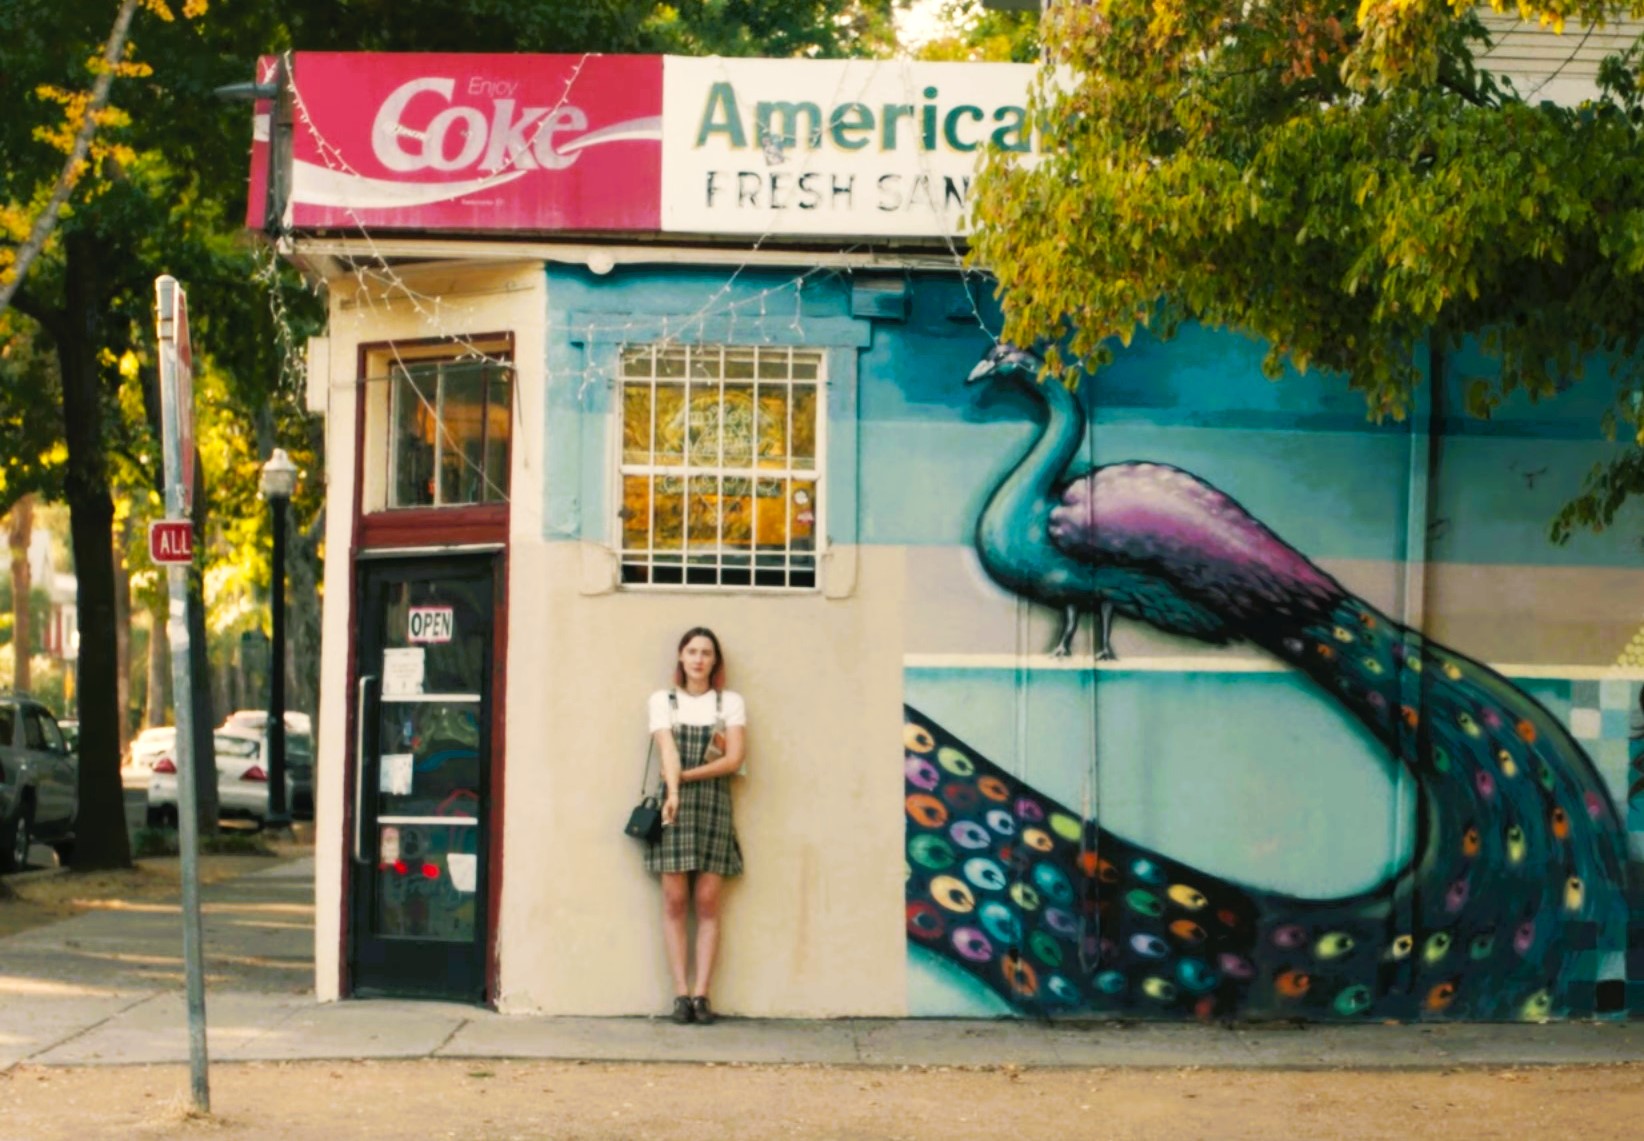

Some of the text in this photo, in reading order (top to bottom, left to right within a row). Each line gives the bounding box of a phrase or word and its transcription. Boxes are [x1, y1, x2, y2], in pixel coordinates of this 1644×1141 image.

[467, 76, 519, 98] Enjoy
[371, 77, 588, 172] Coke
[706, 171, 970, 212] FRESH SAN
[160, 530, 191, 554] ALL
[411, 612, 451, 637] OPEN
